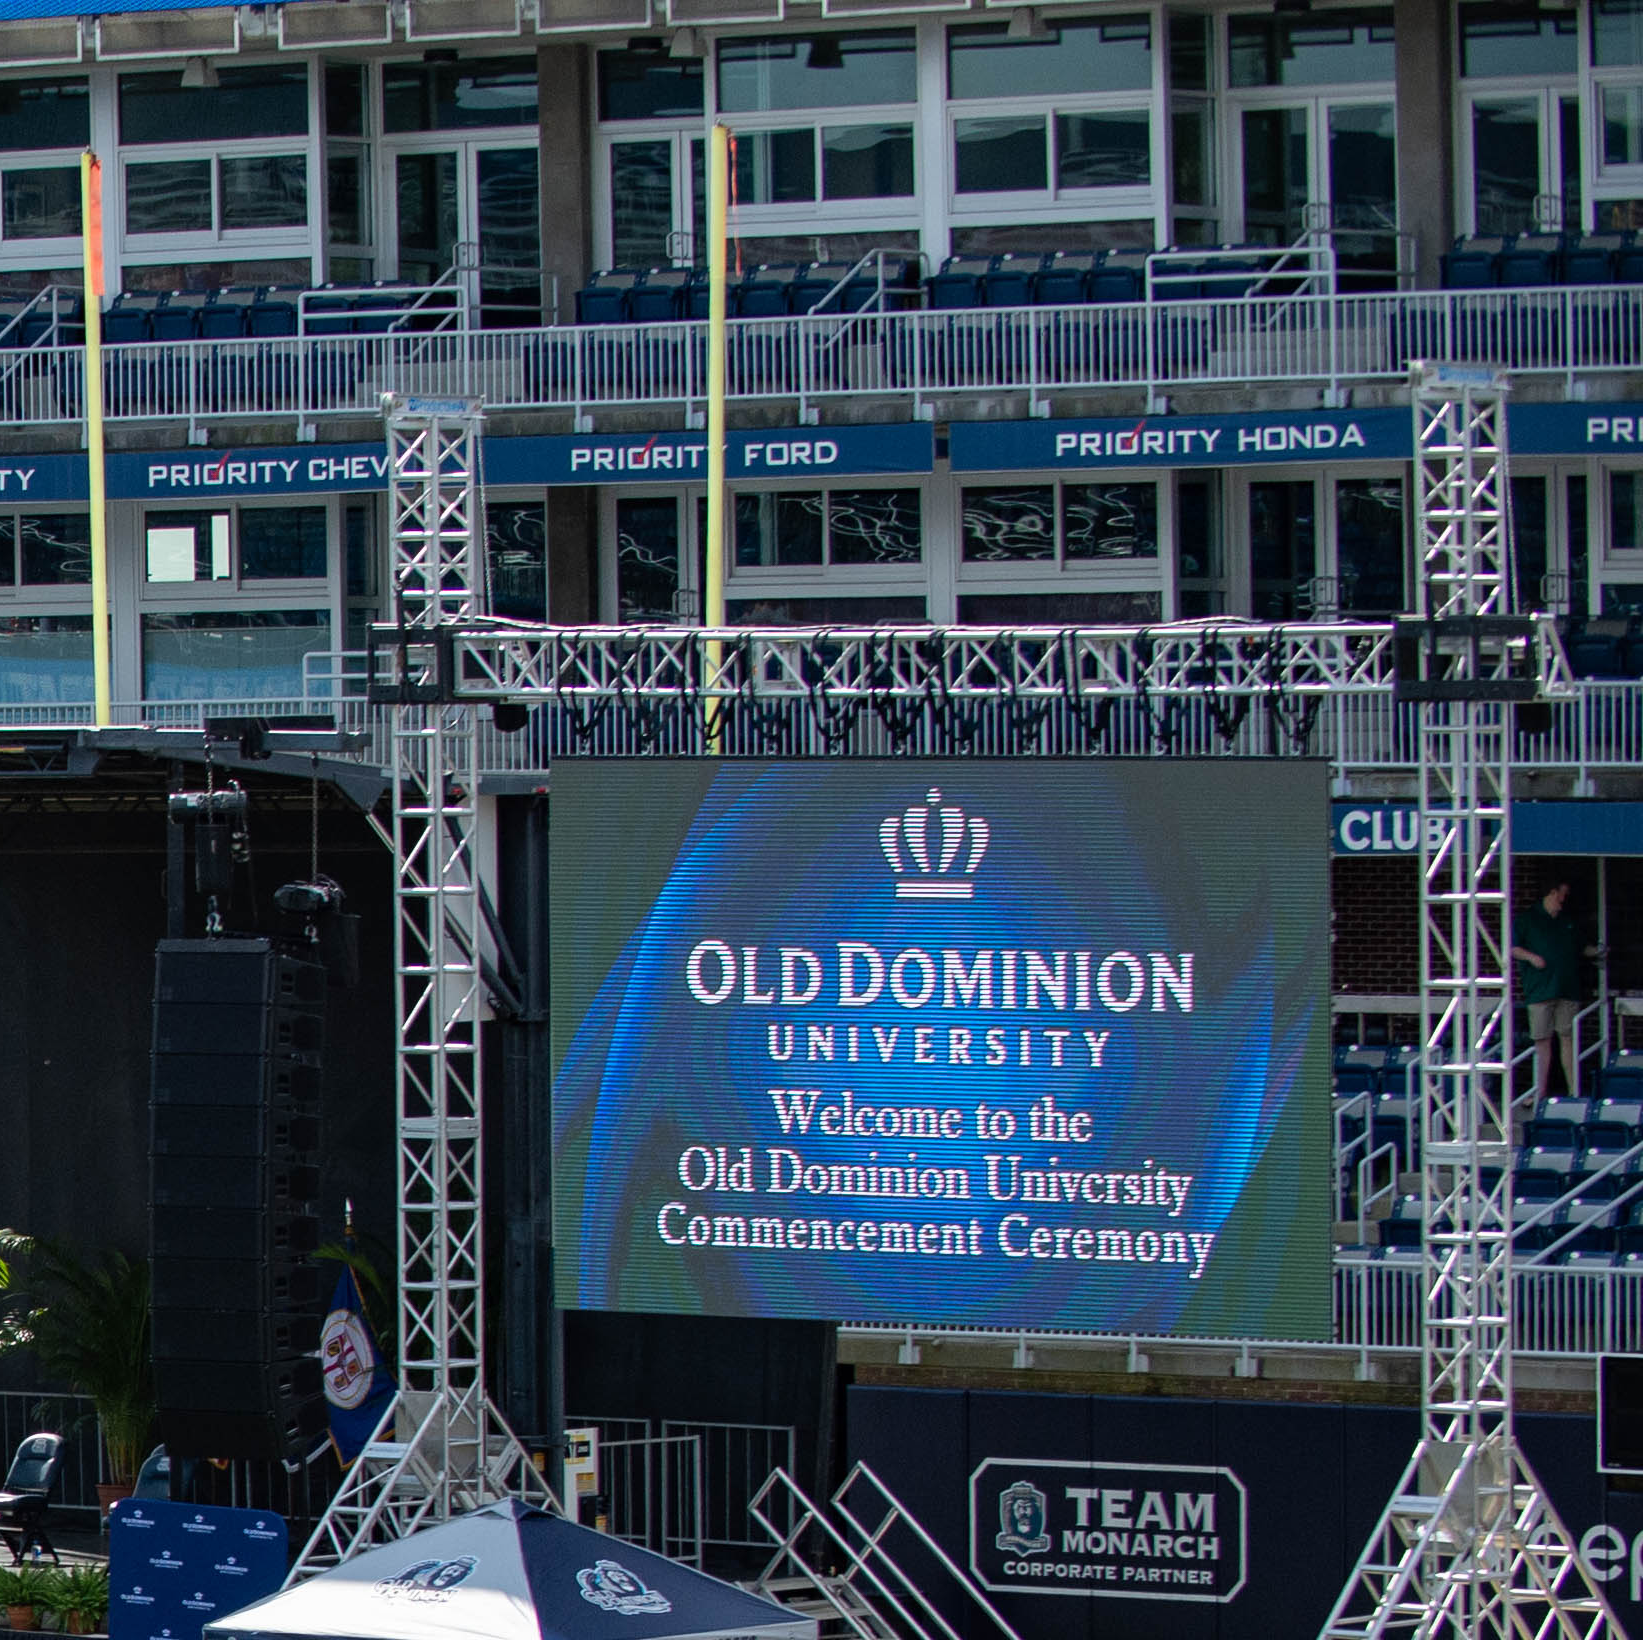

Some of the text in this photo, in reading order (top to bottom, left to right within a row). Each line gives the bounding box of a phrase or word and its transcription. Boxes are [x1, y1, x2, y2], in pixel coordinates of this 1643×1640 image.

[571, 441, 838, 471] PRIORITY FORD
[1056, 425, 1365, 457] PRIORITY HONDA
[148, 461, 298, 487] PRIORITY
[686, 939, 1195, 1014] OLD DOMINION
[769, 1024, 1111, 1068] UNIVERSITY
[769, 1090, 1093, 1145] Welcome to the
[678, 1146, 1193, 1216] Old Dominion University
[656, 1202, 1213, 1280] Commencement Ceremony
[1065, 1486, 1215, 1533] TEAM
[1062, 1530, 1220, 1560] MONARCH
[1003, 1561, 1214, 1585] CORPORATE PARTNER
